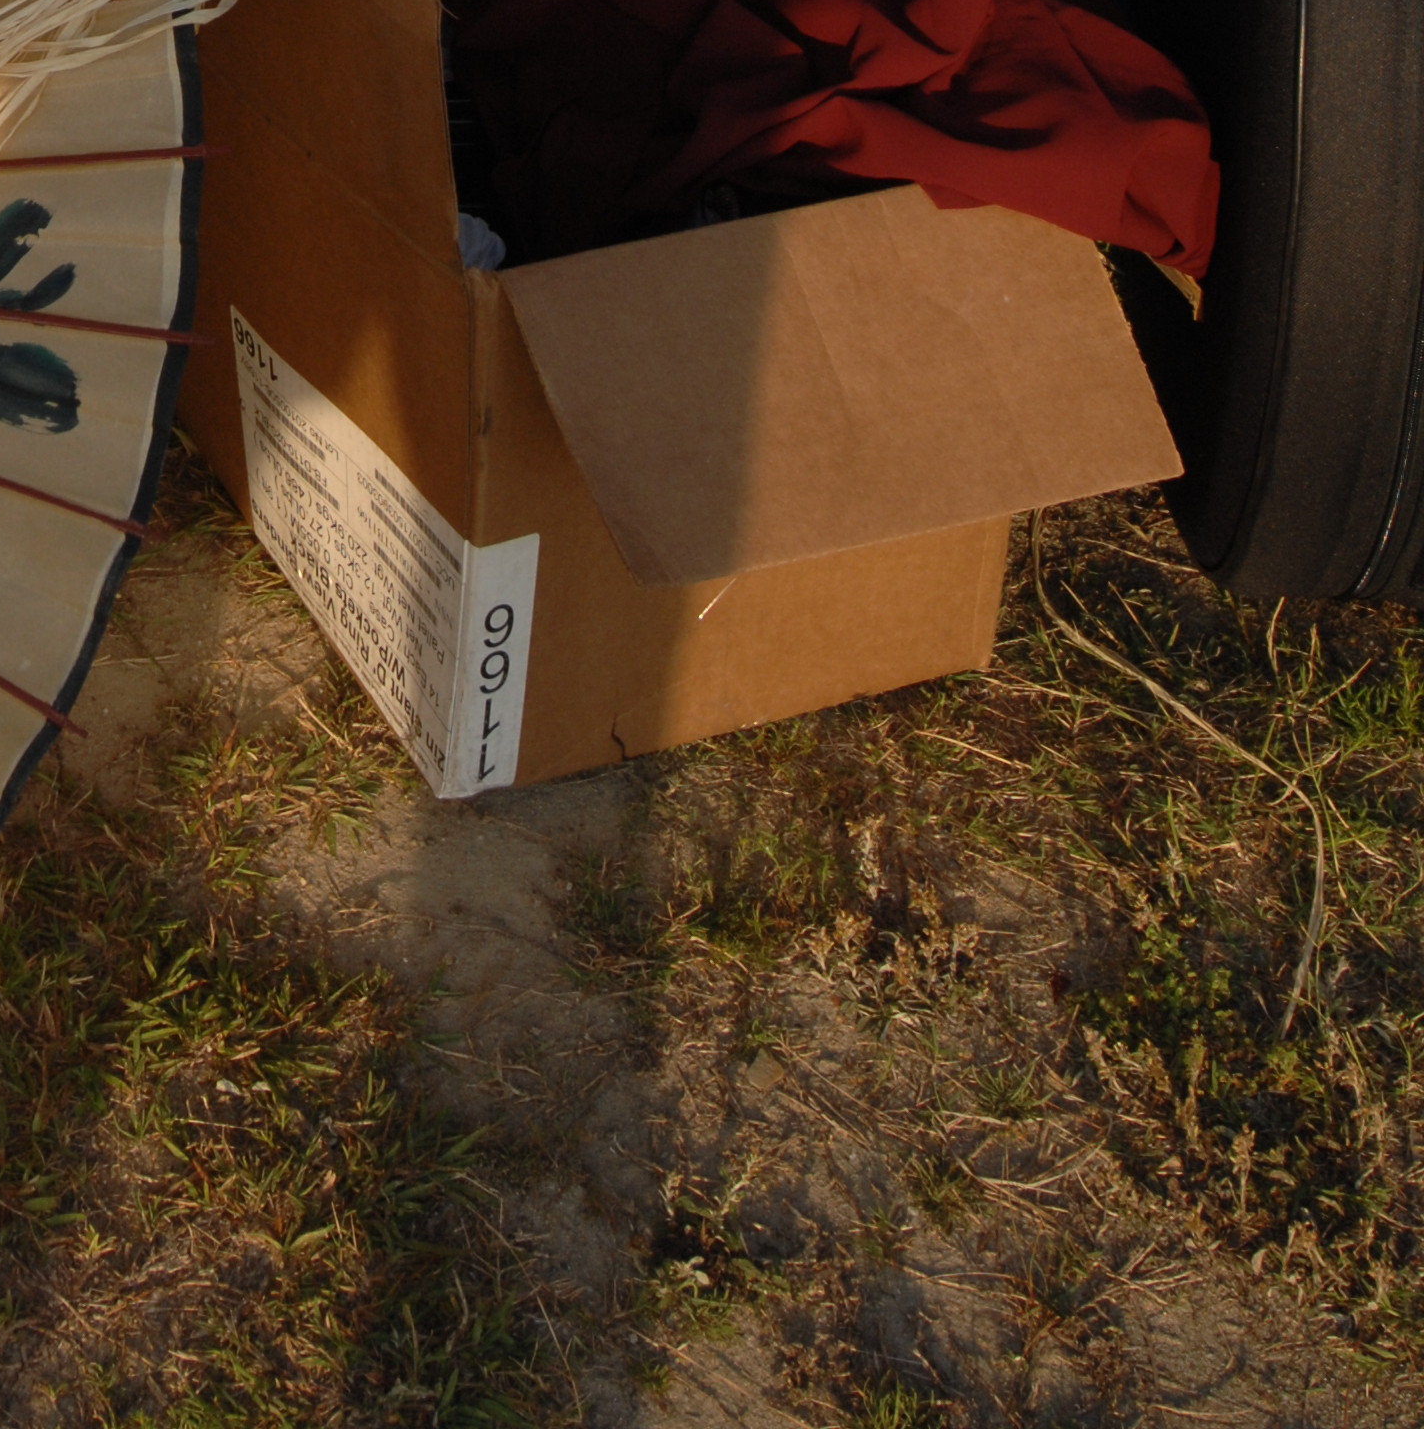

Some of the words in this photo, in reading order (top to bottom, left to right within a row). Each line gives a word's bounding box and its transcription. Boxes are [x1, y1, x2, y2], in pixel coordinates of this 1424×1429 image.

[234, 318, 277, 380] 1166
[325, 440, 338, 461] Lot
[253, 500, 297, 573] Binders
[290, 533, 329, 589] Black
[302, 568, 336, 619] View
[398, 591, 414, 623] Net
[335, 583, 404, 685] W/Pockets
[340, 608, 369, 663] Ring
[369, 601, 394, 642] Case
[406, 625, 422, 657] Net
[418, 617, 444, 664] Pallet
[404, 645, 427, 688] Each
[429, 684, 439, 707] 14
[478, 603, 515, 784] 1166
[426, 732, 444, 771] 2in
